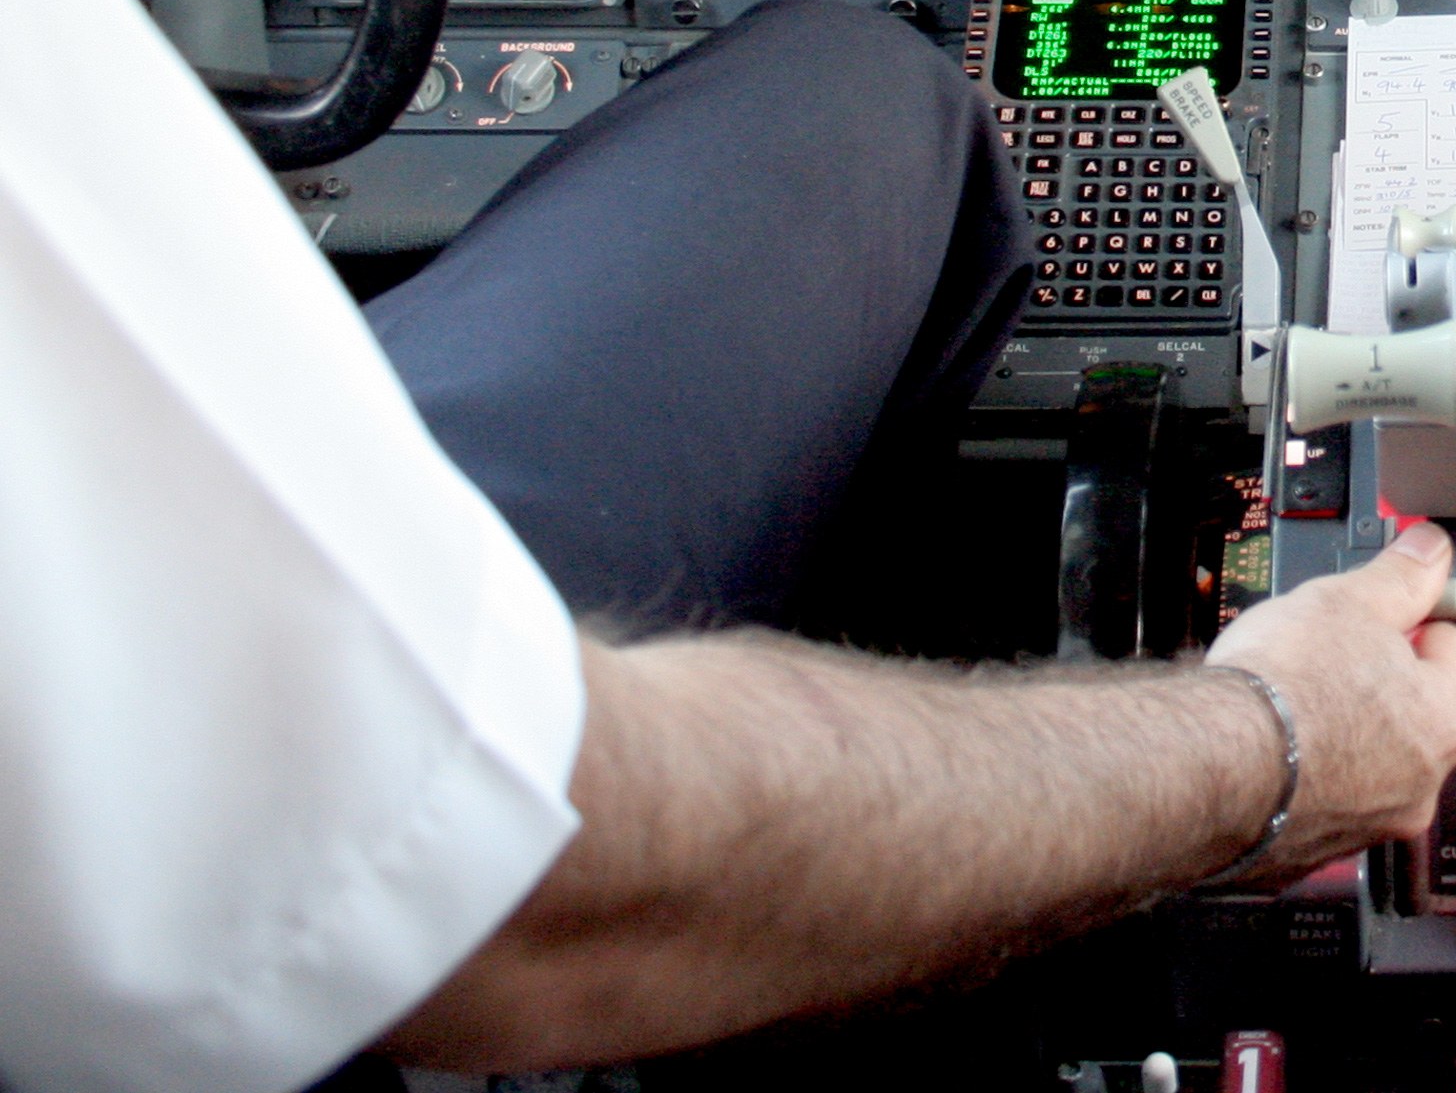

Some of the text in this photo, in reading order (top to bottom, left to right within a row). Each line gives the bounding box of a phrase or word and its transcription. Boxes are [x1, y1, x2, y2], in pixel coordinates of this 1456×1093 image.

[1168, 89, 1202, 129] BRAKE
[1181, 80, 1214, 120] SPEED
[1157, 342, 1205, 352] SELCAL
[1369, 344, 1384, 373] 1
[1307, 448, 1326, 458] UP
[1237, 1047, 1260, 1093] 1
